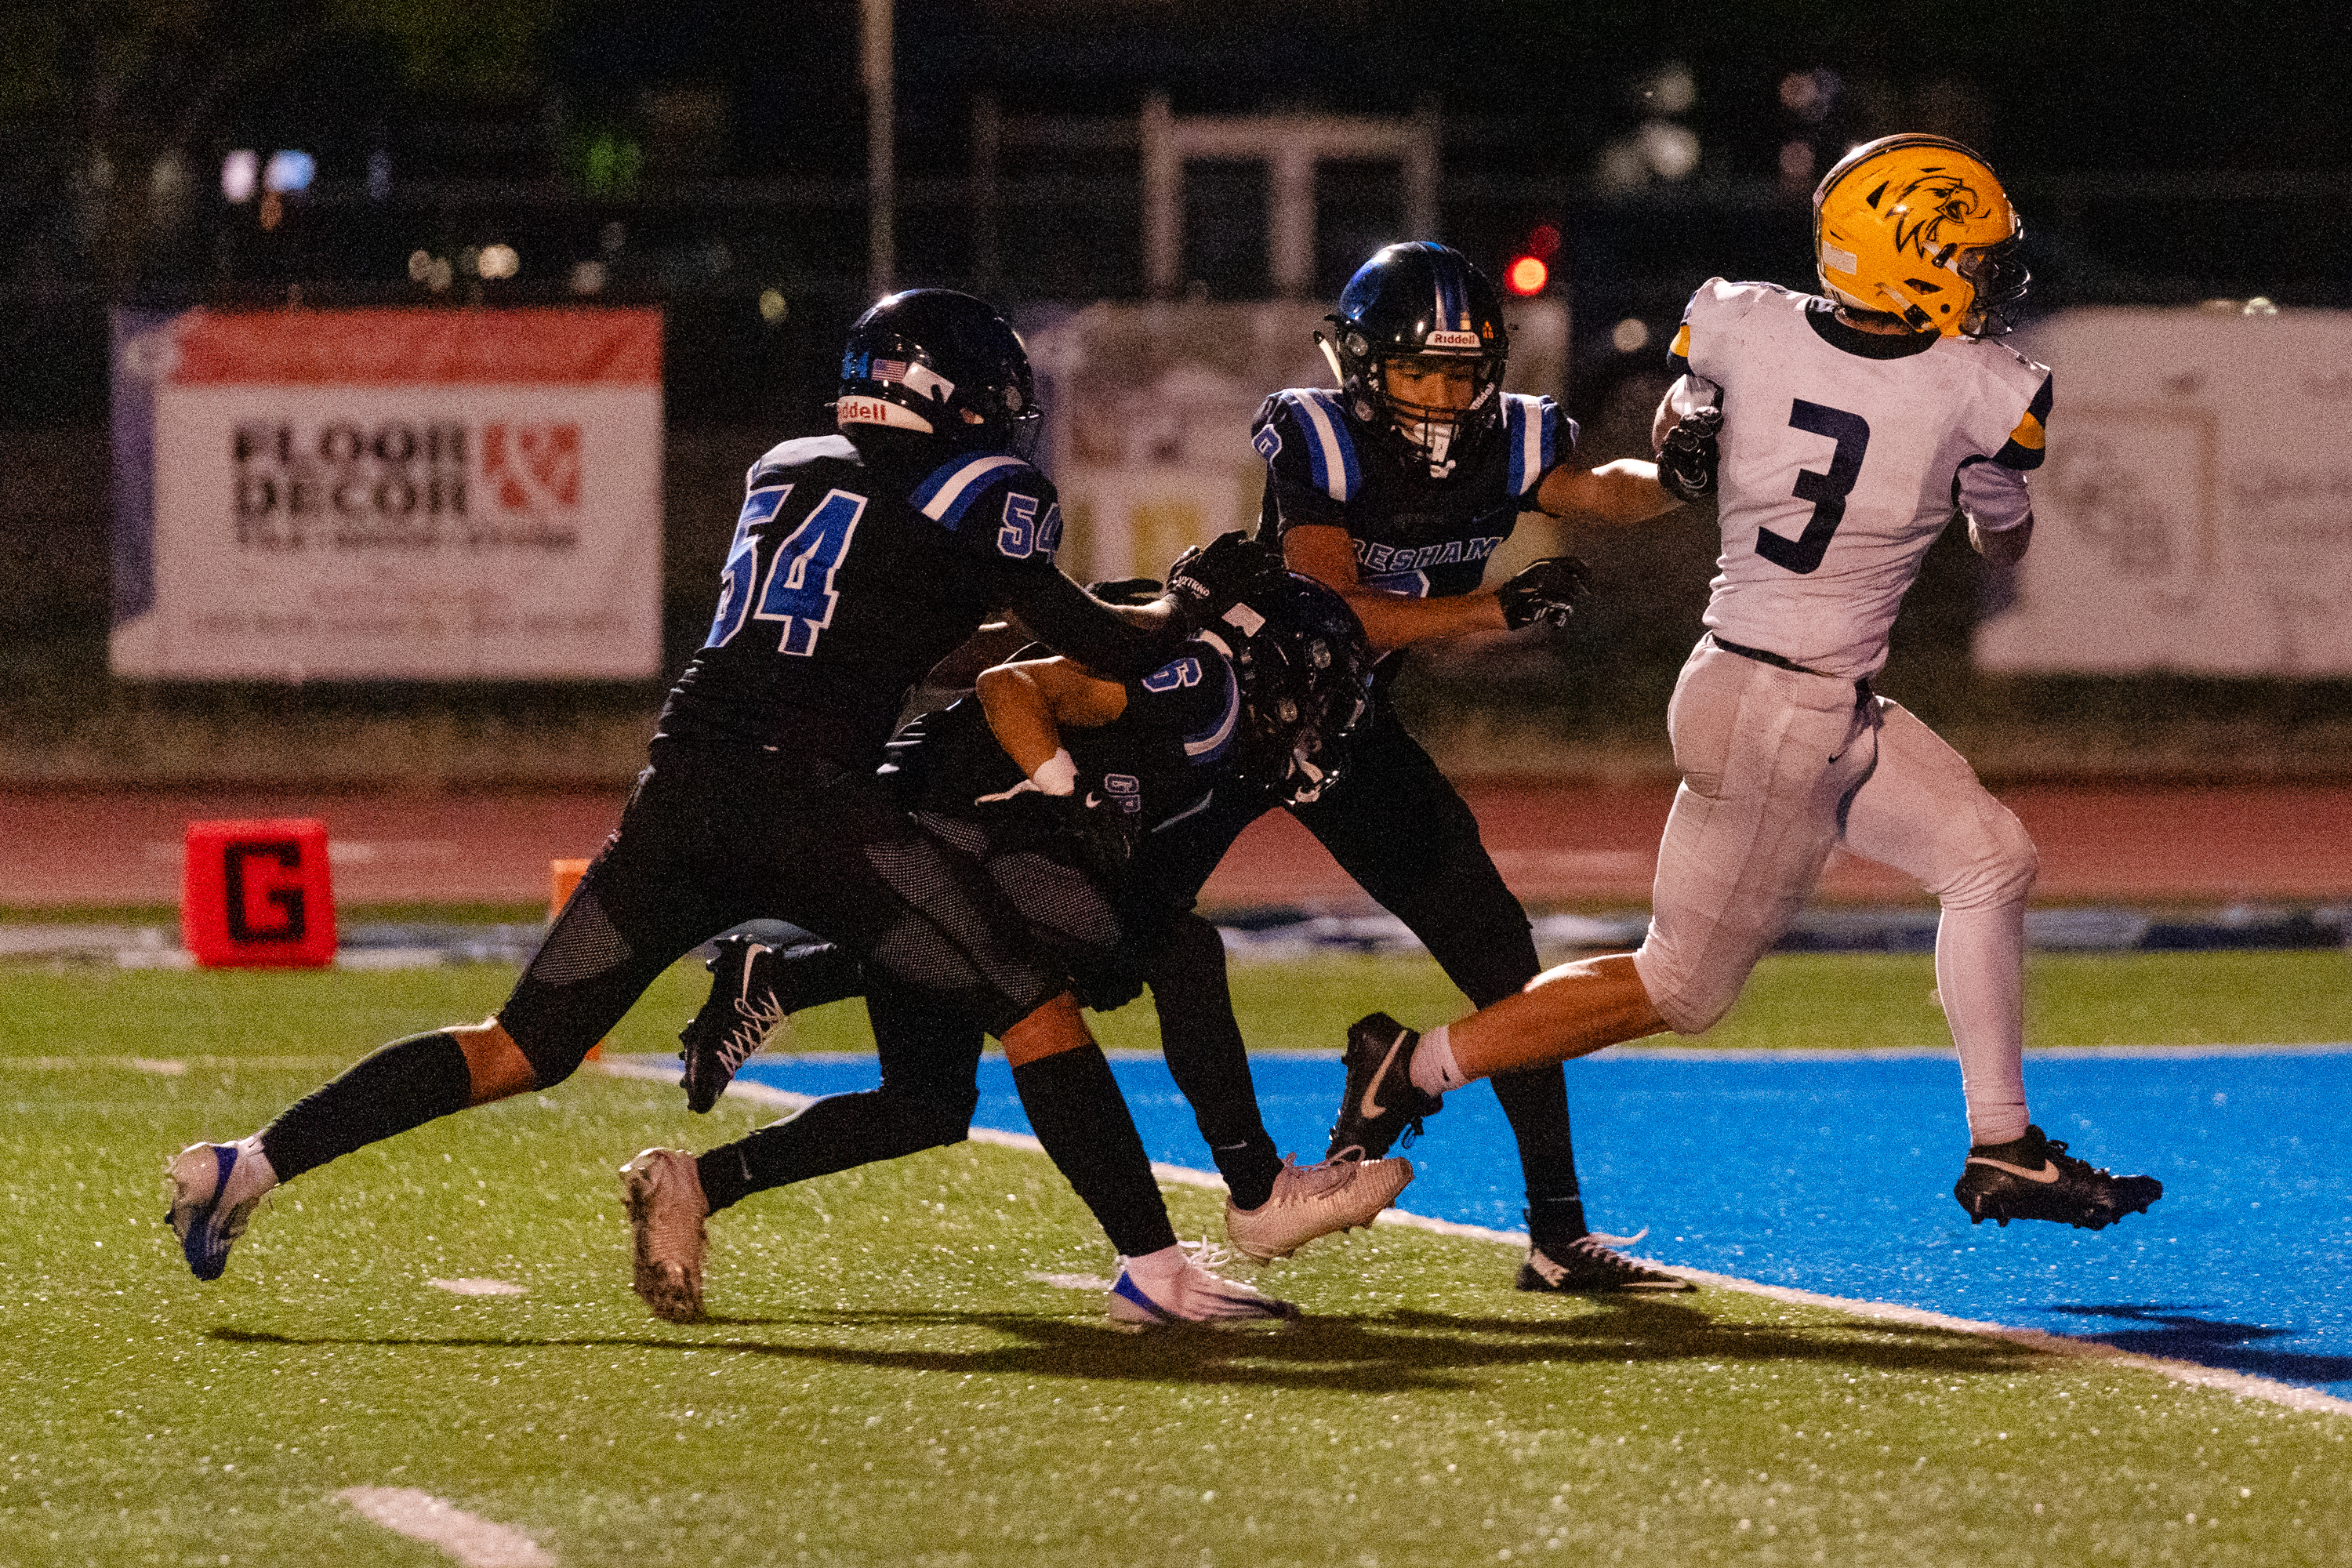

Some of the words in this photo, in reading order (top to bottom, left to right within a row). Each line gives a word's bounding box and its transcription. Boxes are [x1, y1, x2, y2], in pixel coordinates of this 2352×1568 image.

[1434, 333, 1476, 346] Riddell
[840, 401, 887, 422] ddell
[1755, 397, 1871, 575] 3
[996, 492, 1062, 564] 54
[1352, 536, 1504, 572] RESHAM
[703, 483, 869, 658] 54
[224, 840, 305, 946] G
